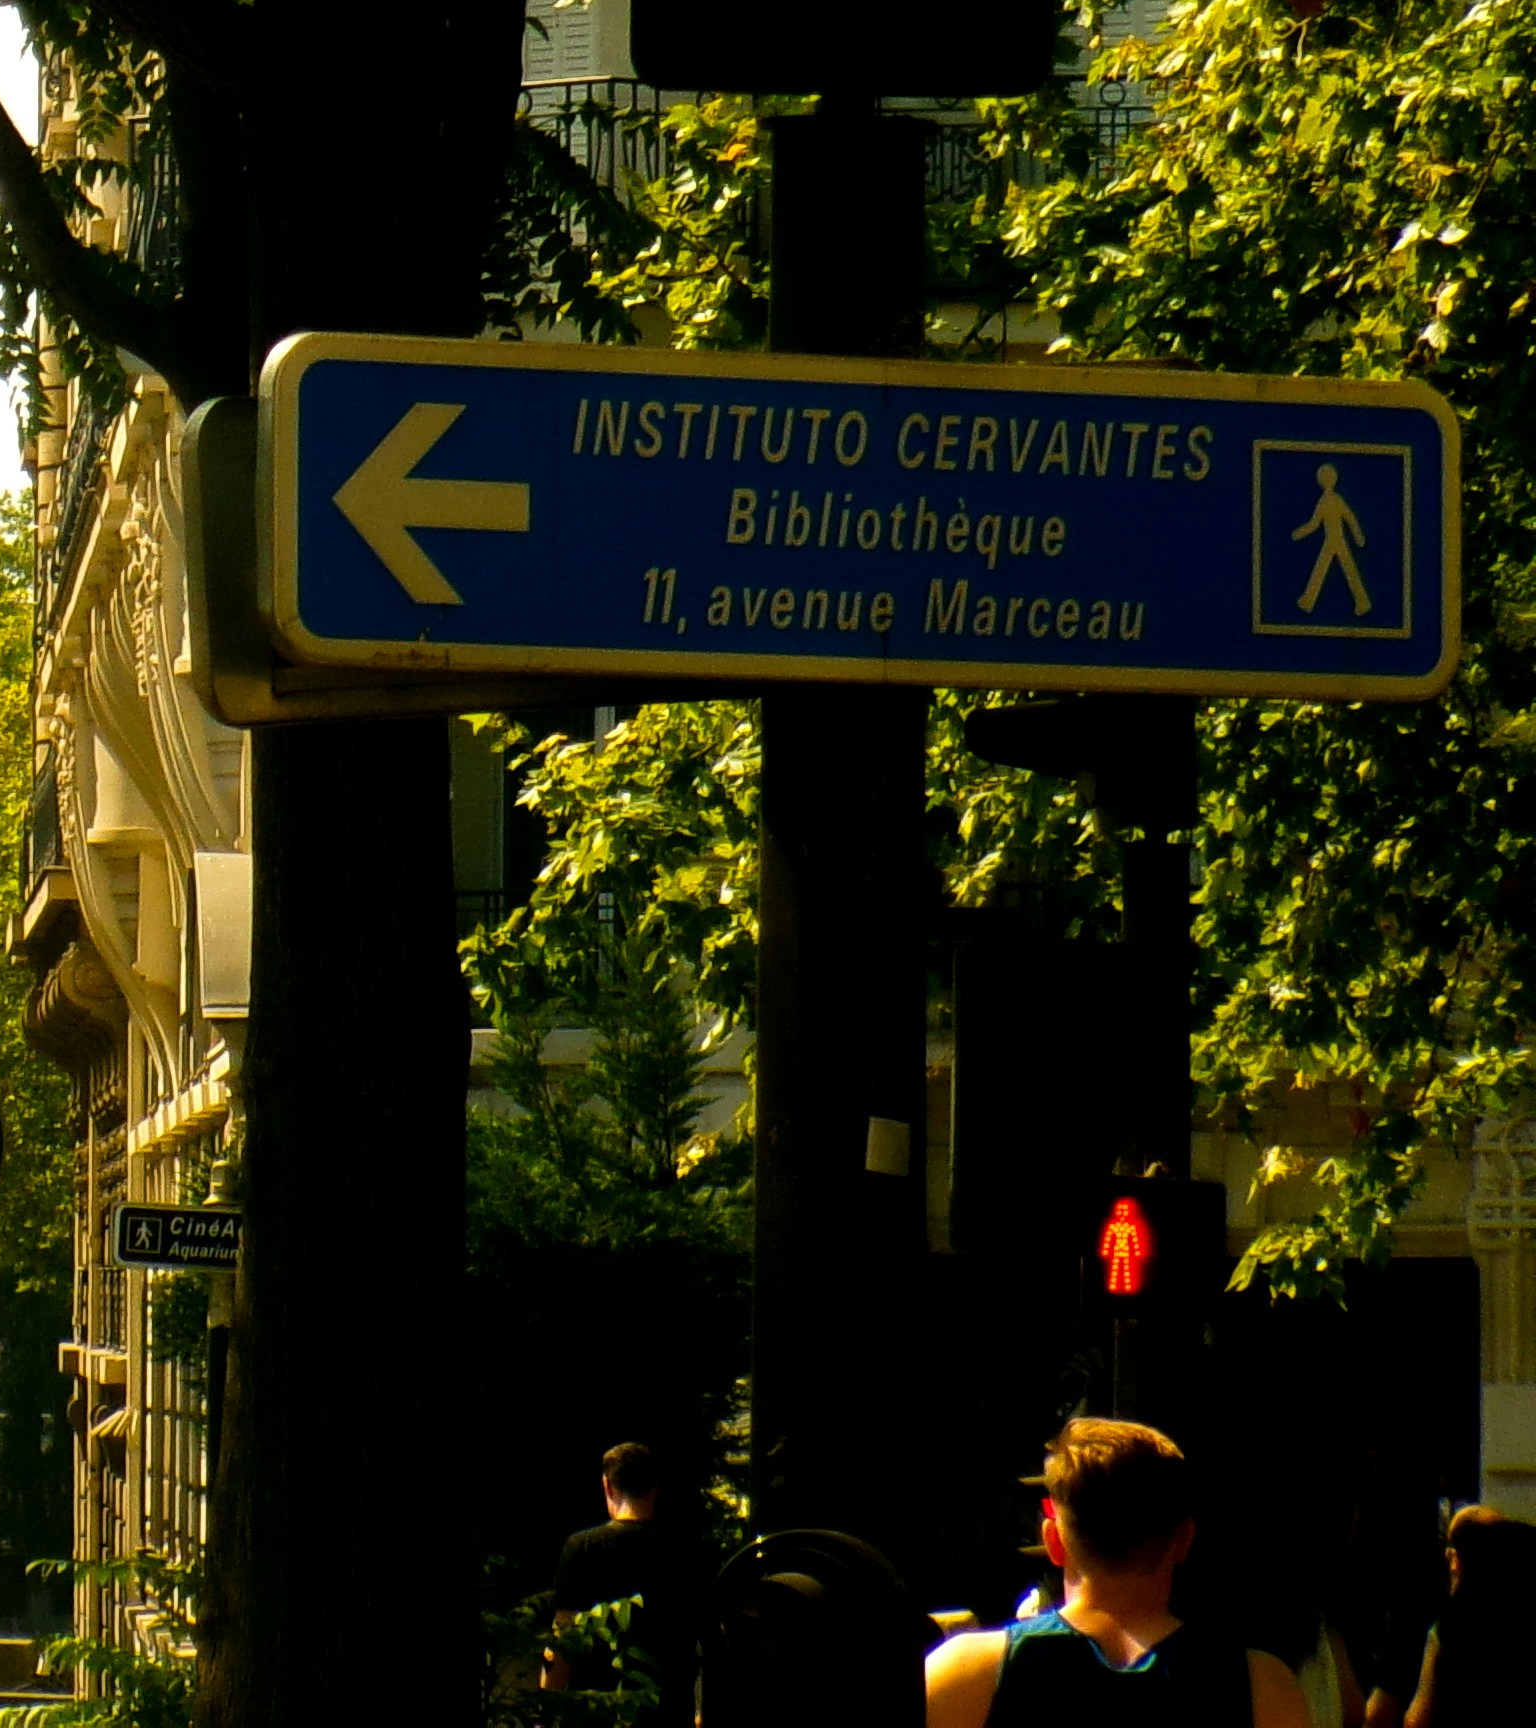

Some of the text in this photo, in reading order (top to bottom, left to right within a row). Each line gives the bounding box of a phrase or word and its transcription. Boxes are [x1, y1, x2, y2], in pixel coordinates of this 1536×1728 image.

[573, 399, 1214, 481] INSTITUTO CERVANTES
[726, 487, 1067, 570] Bibliothèque
[642, 568, 1145, 641] 11, avenue Marceau
[170, 1216, 243, 1239] CinéA
